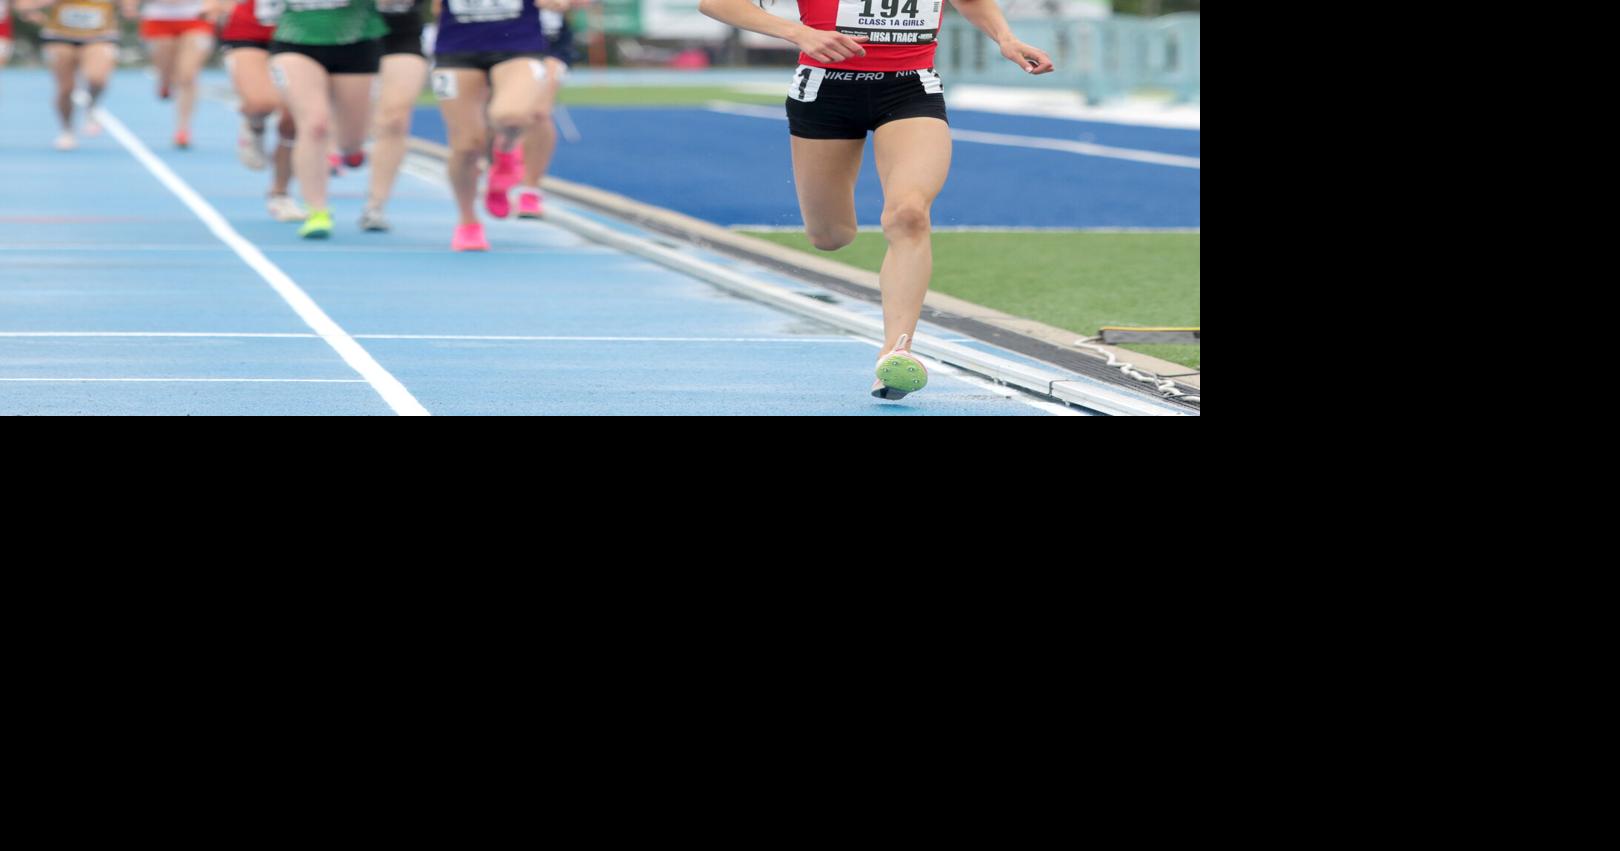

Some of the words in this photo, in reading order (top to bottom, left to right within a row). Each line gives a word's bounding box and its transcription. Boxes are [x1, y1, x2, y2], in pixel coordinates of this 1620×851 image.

[858, 0, 919, 18] 194
[858, 18, 886, 26] CLASS
[902, 19, 925, 27] GIRLS
[869, 31, 891, 42] IHSA
[892, 32, 918, 43] TRACK
[823, 71, 853, 81] NIKE
[855, 72, 885, 81] PRO
[895, 70, 919, 78] NIK
[798, 68, 812, 100] 1
